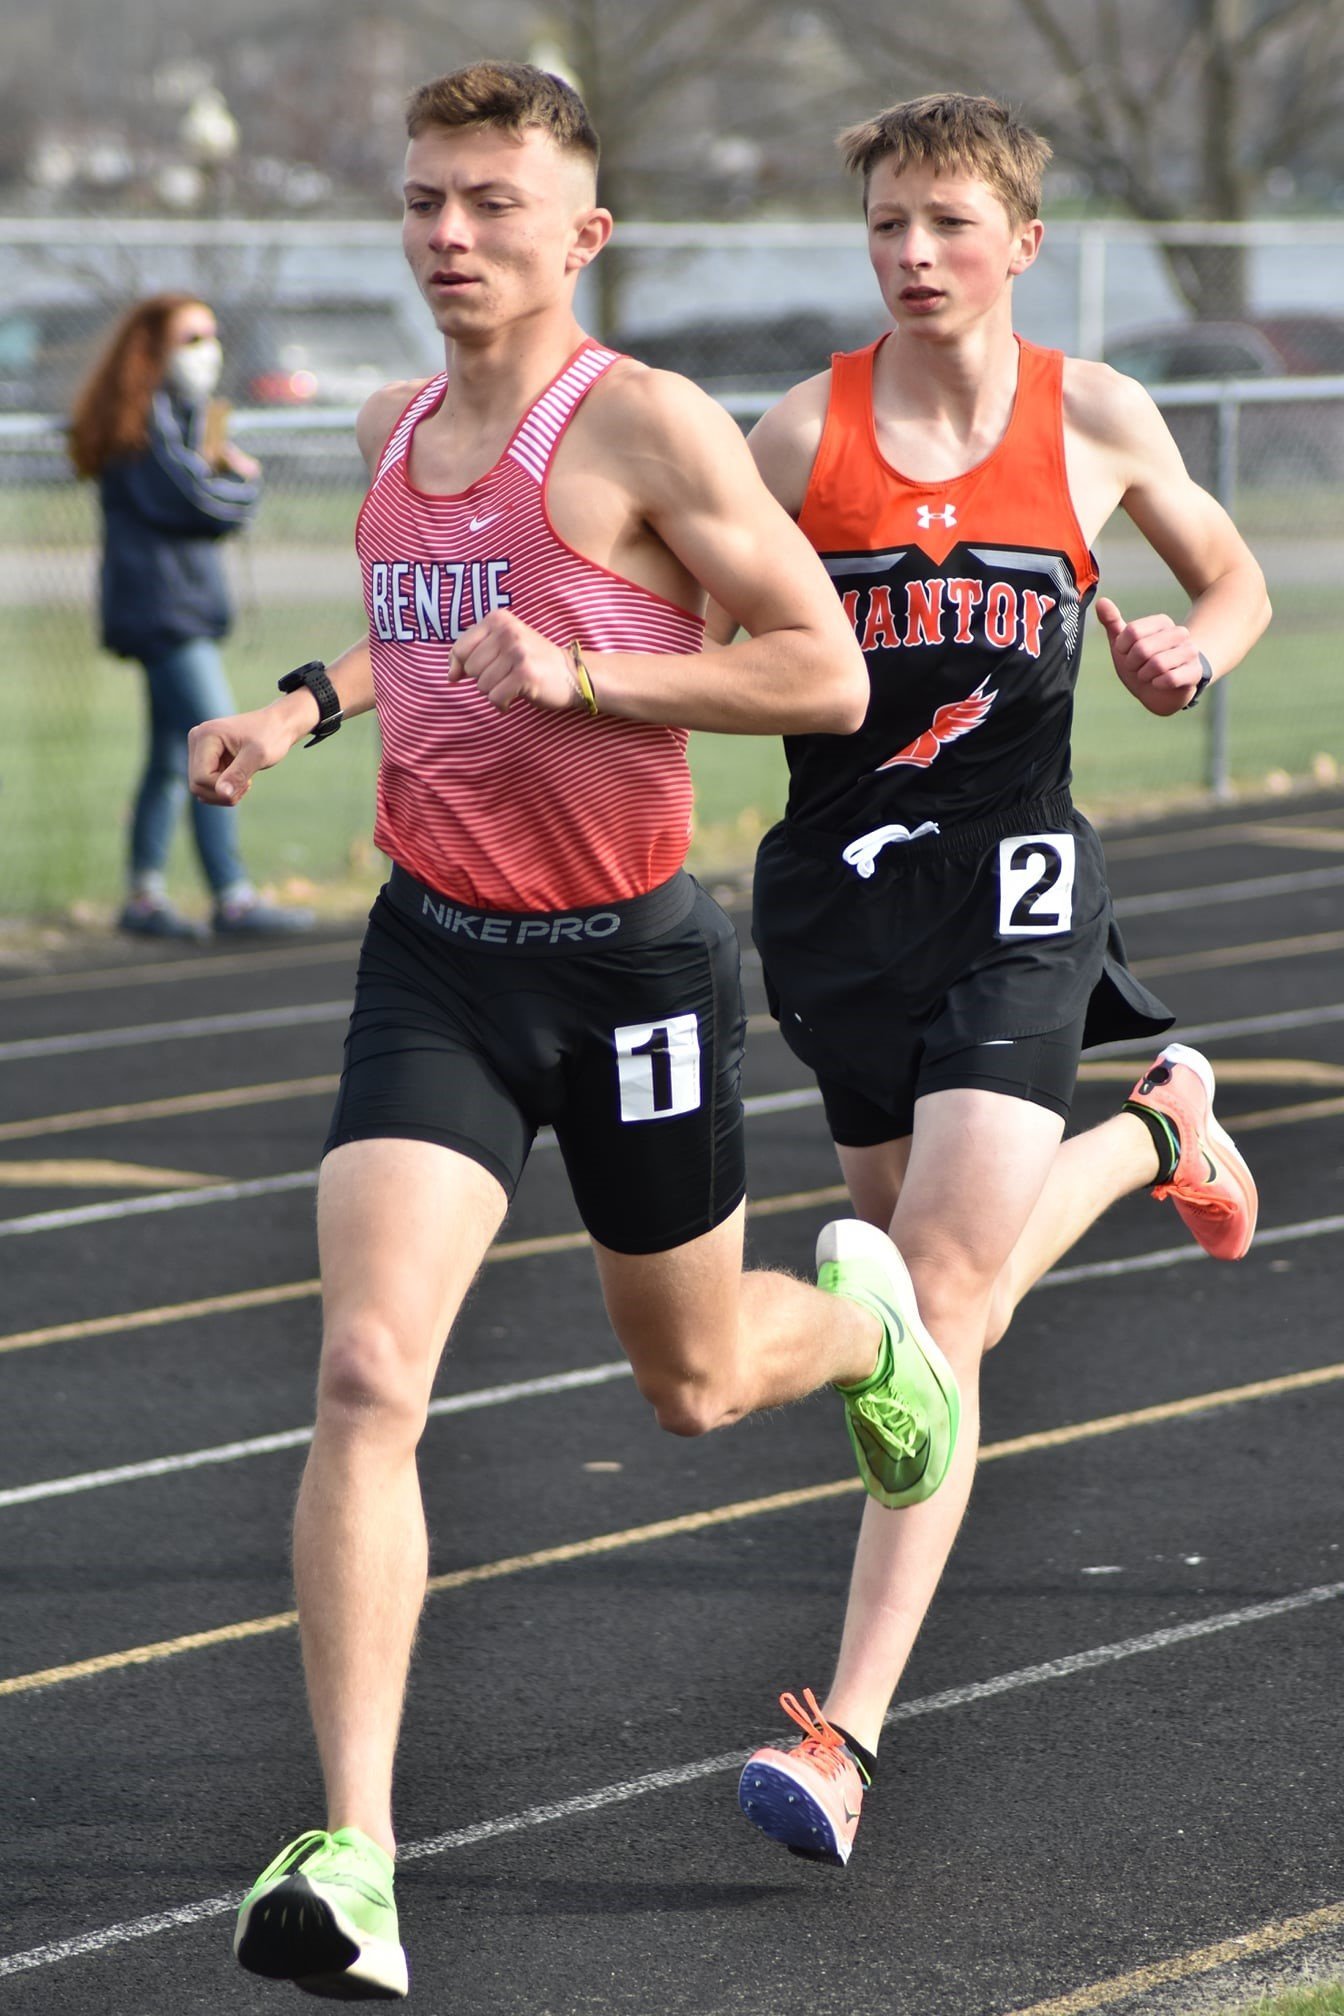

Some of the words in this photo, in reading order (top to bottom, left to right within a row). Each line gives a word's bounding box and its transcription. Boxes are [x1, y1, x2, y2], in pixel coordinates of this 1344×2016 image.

[421, 893, 511, 944] NIKE
[515, 911, 622, 945] PRO
[1009, 841, 1062, 926] 2
[631, 1027, 673, 1112] 1
